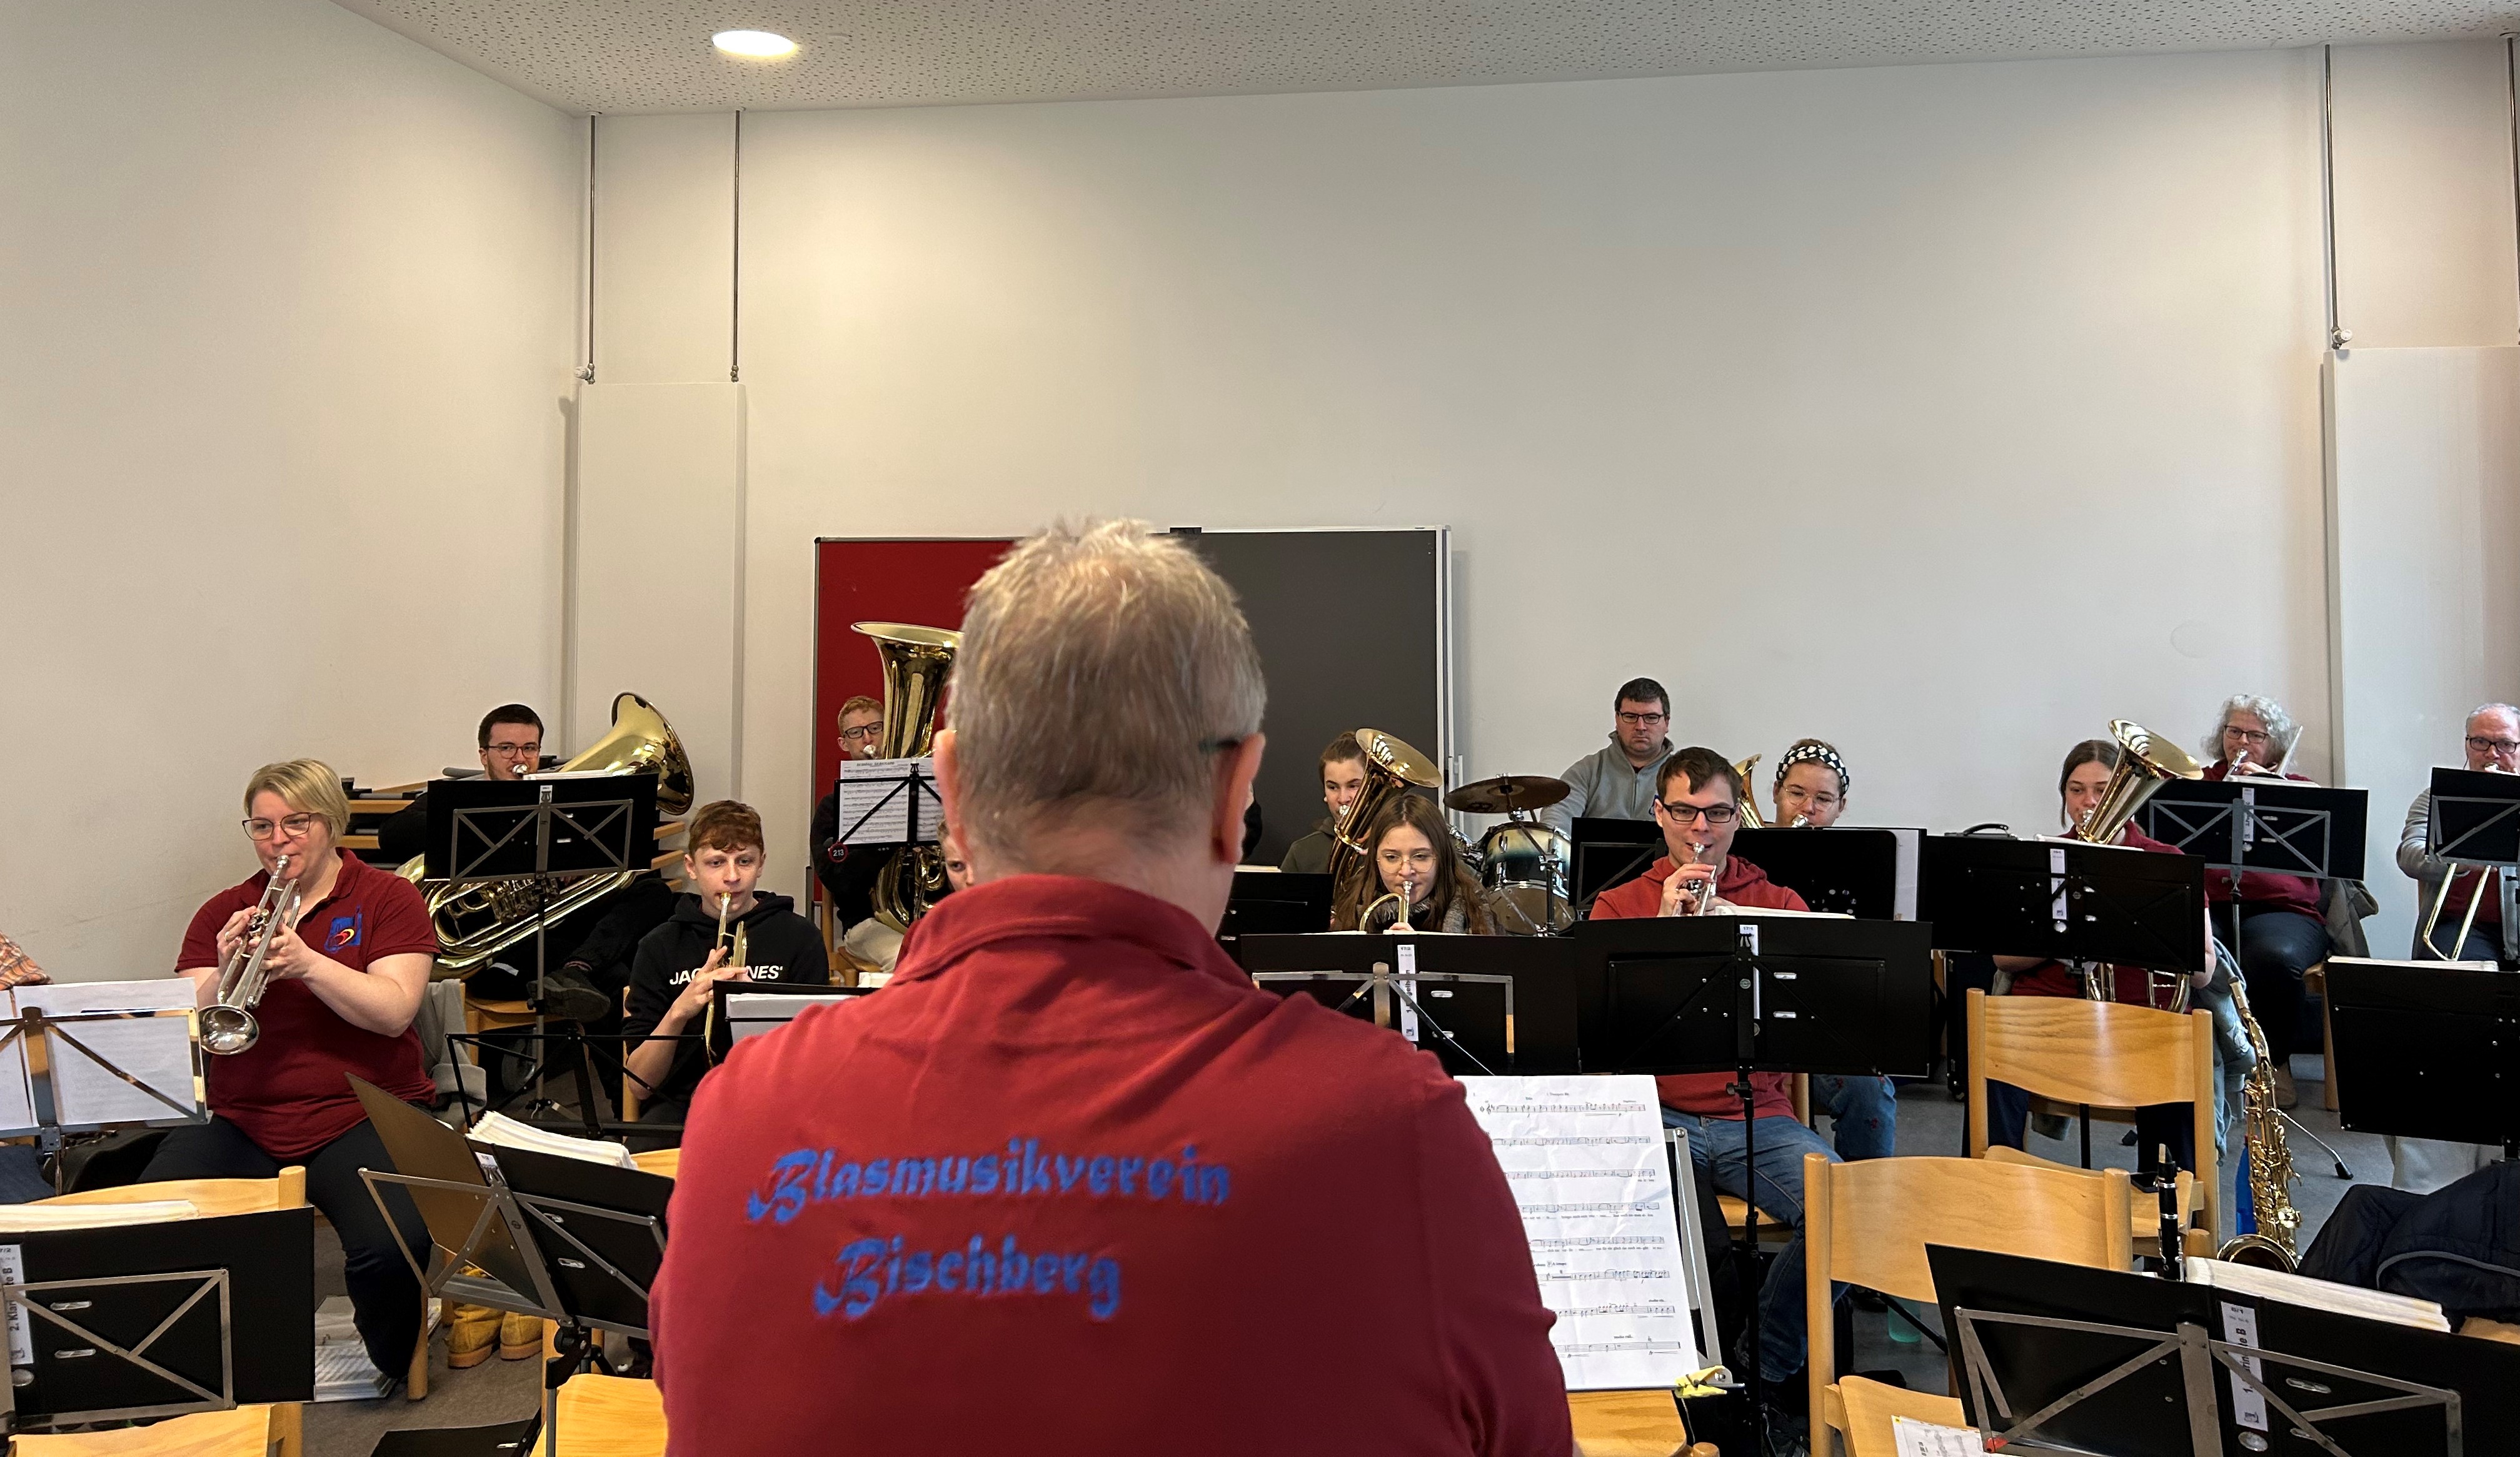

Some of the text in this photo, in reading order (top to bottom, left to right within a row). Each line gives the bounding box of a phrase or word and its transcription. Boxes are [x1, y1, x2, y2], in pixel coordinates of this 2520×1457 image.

[833, 849, 845, 857] 213
[669, 965, 780, 986] JAC NES
[745, 1137, 1231, 1224] Blasmusikverein
[813, 1234, 1122, 1321] Bischberg
[2236, 1328, 2247, 1336] B
